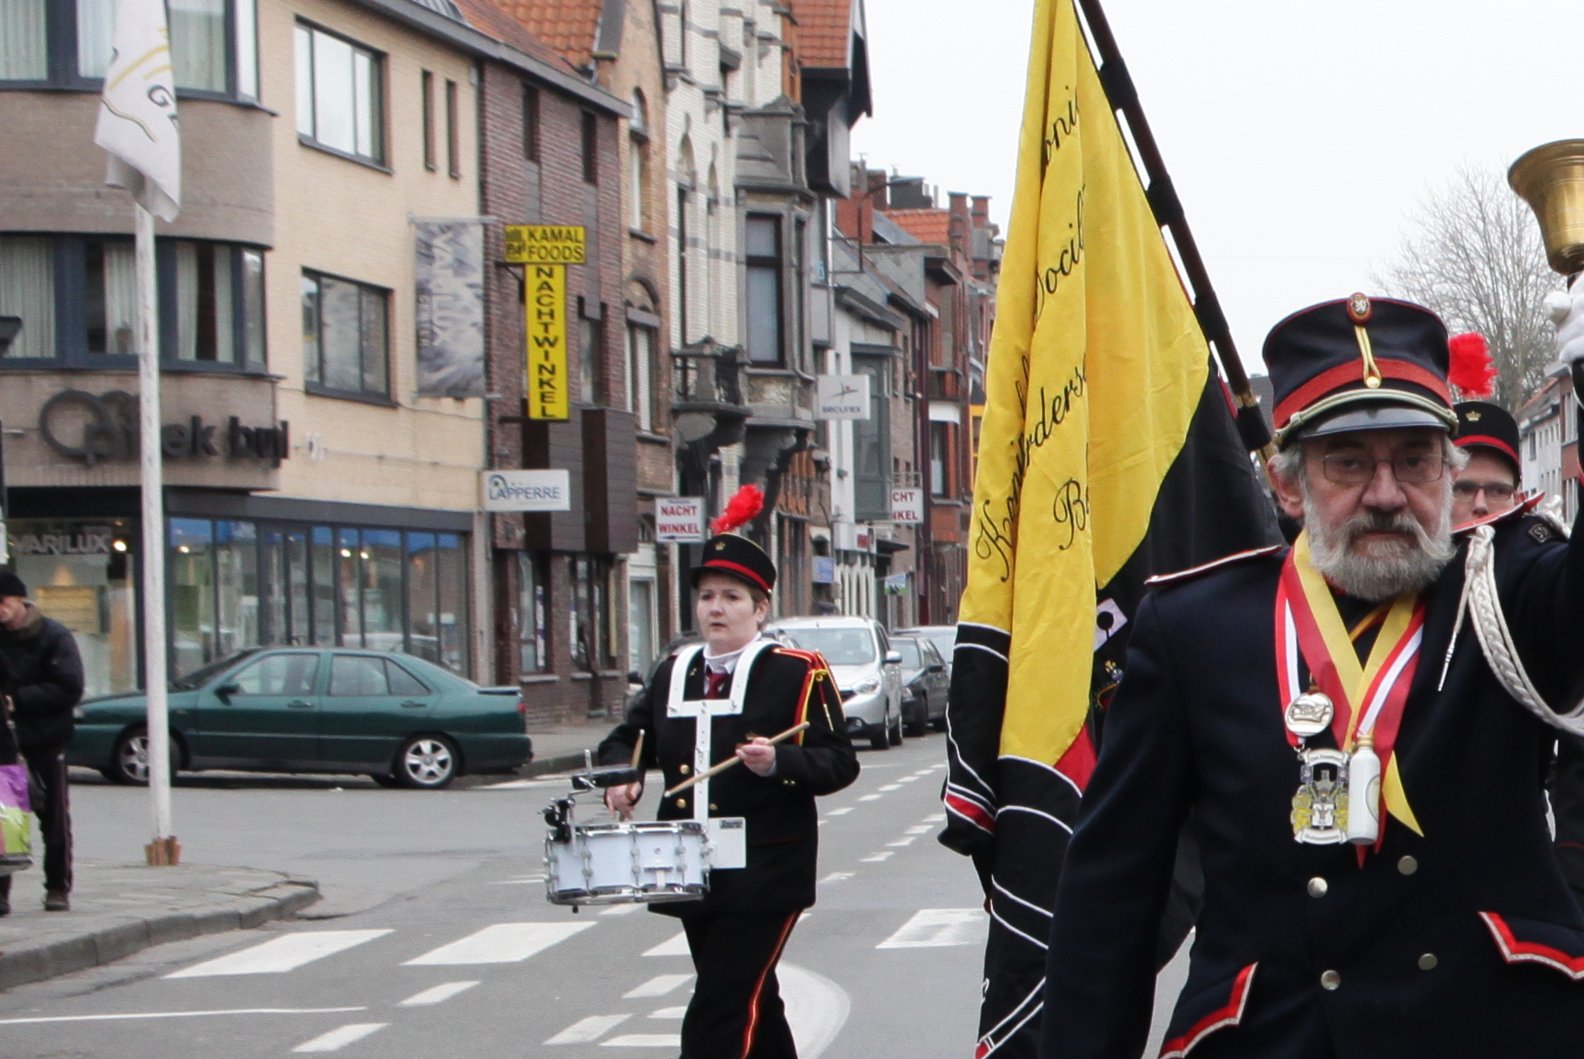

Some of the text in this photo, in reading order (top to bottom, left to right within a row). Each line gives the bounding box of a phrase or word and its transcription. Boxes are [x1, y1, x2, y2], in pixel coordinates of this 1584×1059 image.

[527, 228, 583, 244] KAMAL
[528, 244, 585, 261] FOODS
[532, 266, 559, 419] NACHTWINKEL
[488, 485, 561, 500] LAPPERRE
[660, 505, 698, 517] NACHT
[658, 522, 700, 535] WINKEL
